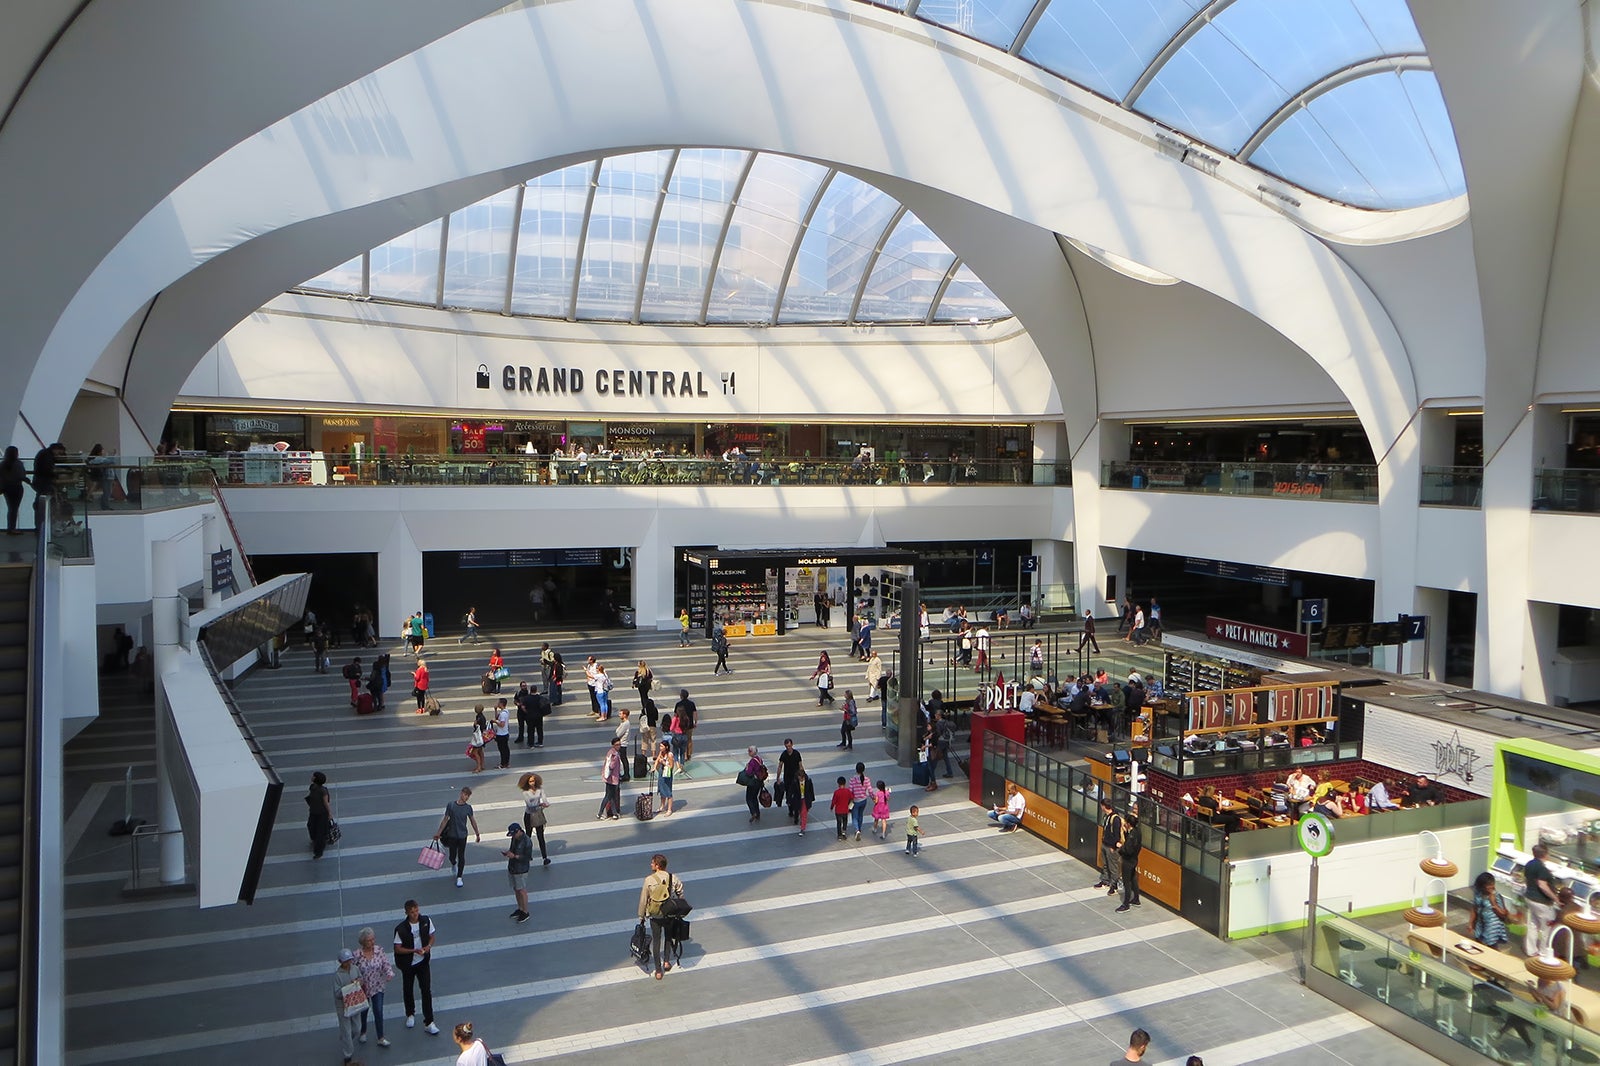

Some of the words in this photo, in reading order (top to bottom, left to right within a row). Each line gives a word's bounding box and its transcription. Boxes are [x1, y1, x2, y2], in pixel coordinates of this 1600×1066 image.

[503, 365, 584, 393] GRAND
[596, 369, 708, 397] CENTRAL
[610, 427, 656, 435] MONSOON
[981, 552, 987, 560] 4
[1028, 559, 1033, 568] 5
[1310, 604, 1318, 616] 6
[1413, 621, 1420, 634] 7
[1225, 623, 1241, 640] PRET
[1242, 628, 1248, 642] A
[1249, 628, 1278, 648] MANGER
[986, 682, 1019, 710] PRET
[1211, 693, 1314, 723] PRET
[1436, 740, 1476, 777] PRET
[1037, 814, 1057, 829] COFFEE
[1143, 870, 1162, 884] FOOD
